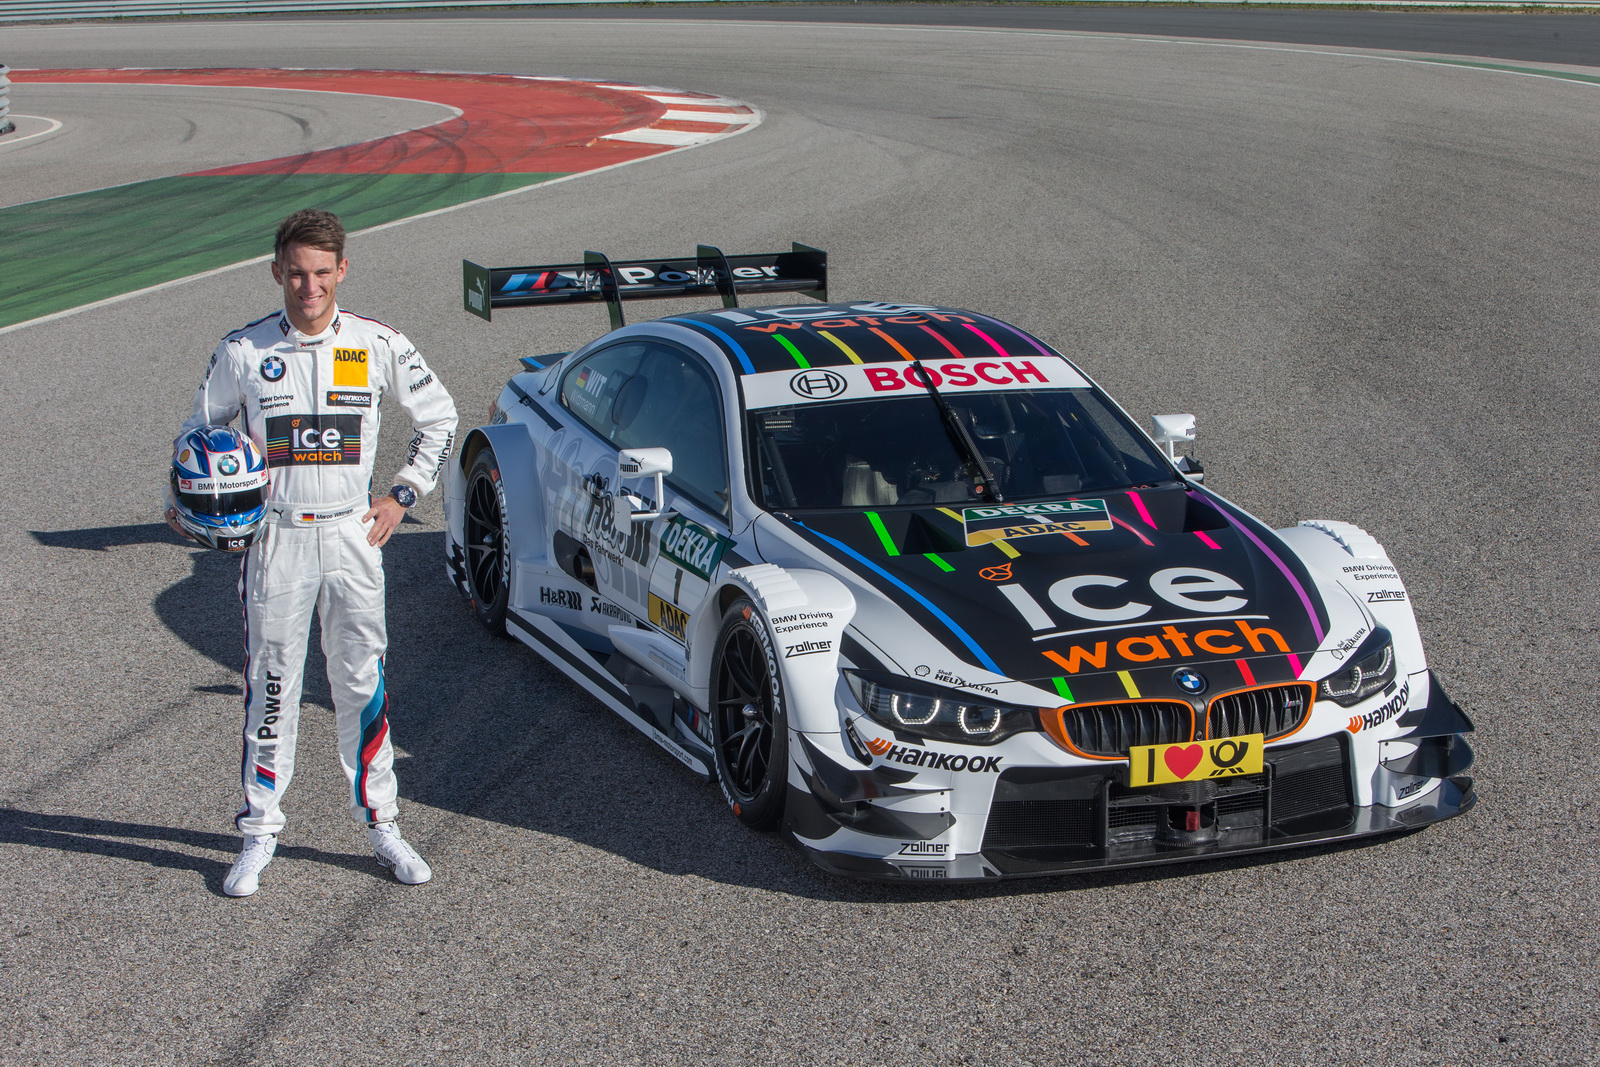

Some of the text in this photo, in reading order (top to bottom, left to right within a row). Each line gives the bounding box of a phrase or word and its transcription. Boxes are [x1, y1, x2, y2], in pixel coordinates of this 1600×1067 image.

[743, 312, 977, 333] watch
[334, 349, 367, 363] ADAC
[585, 369, 608, 398] WIT
[862, 360, 1050, 392] BOSCH
[260, 401, 290, 410] Experience
[292, 428, 341, 448] ice
[293, 450, 342, 462] watch
[219, 478, 259, 490] Motorsport
[972, 501, 1099, 518] DEKRA
[1023, 514, 1054, 524] 1
[1003, 522, 1086, 538] ADAC
[583, 534, 594, 549] Das
[665, 521, 719, 574] DEKRA
[1342, 564, 1395, 573] BMW Driving
[1353, 573, 1399, 581] Experience
[673, 567, 684, 606] 1
[997, 567, 1248, 631] ice
[660, 601, 688, 640] ADAC
[771, 611, 834, 625] BMW Driving
[774, 621, 829, 634] Experience
[1041, 620, 1292, 674] watch
[937, 669, 953, 677] Shell
[934, 673, 999, 696] HELIX ULTRA
[257, 670, 282, 739] Power
[1147, 748, 1156, 783] I
